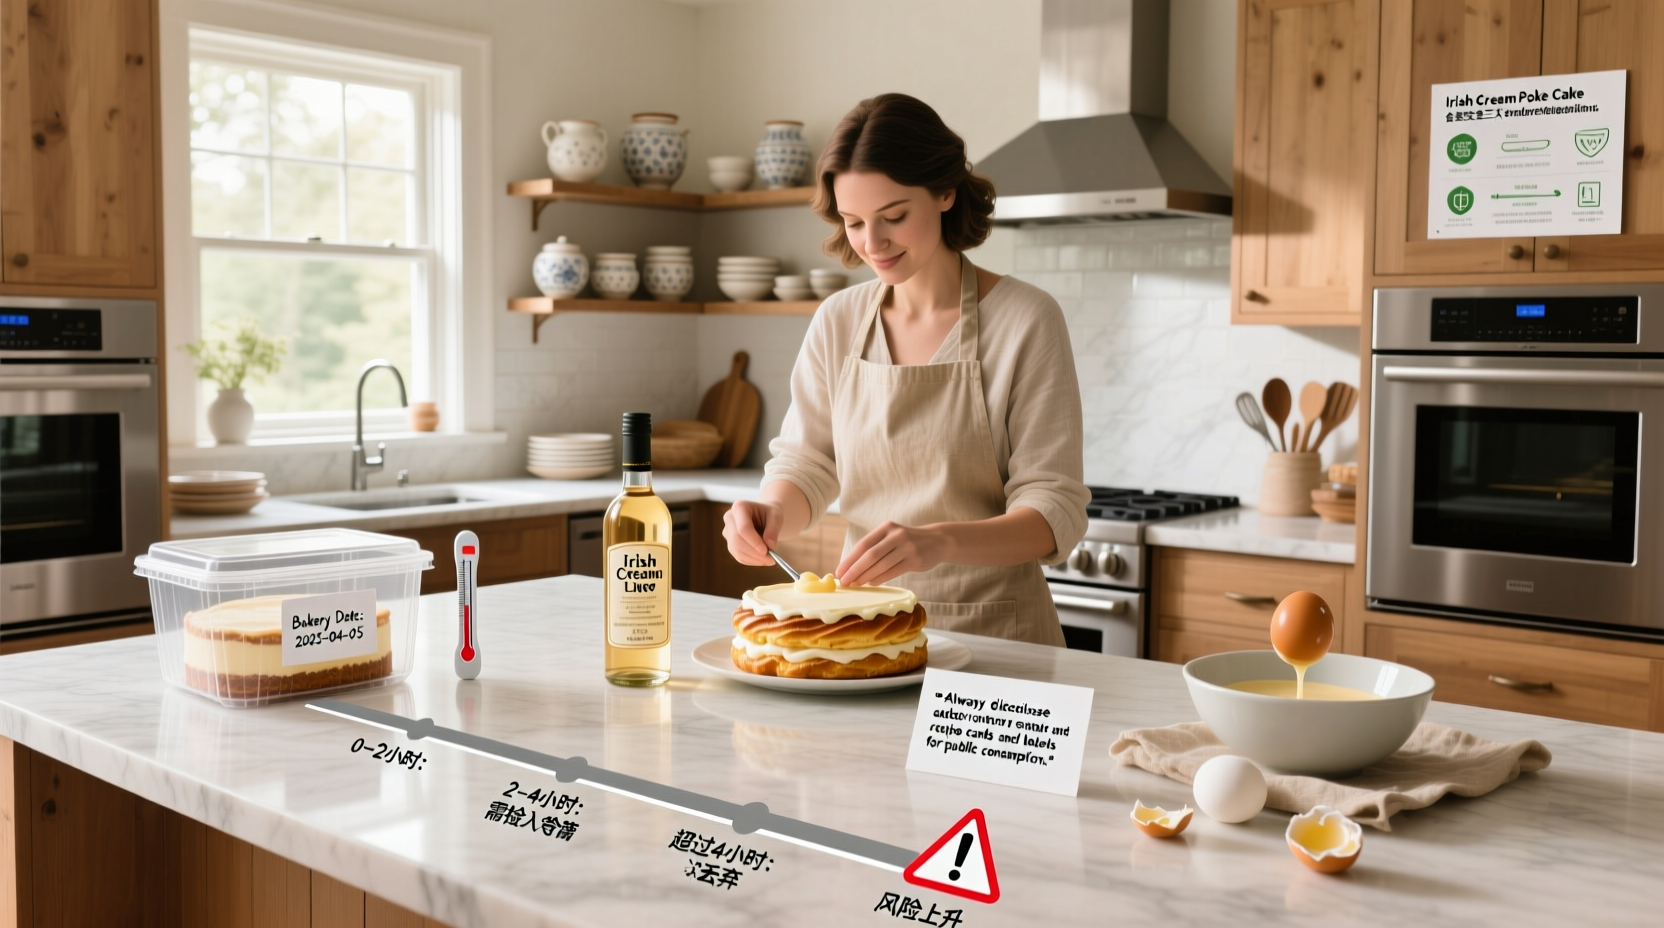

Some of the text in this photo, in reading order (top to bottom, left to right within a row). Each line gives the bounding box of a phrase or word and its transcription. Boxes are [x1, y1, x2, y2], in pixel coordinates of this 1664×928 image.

[1476, 93, 1517, 106] Cream
[1518, 89, 1549, 104] Poke
[1552, 86, 1585, 101] Cake
[624, 553, 657, 568] Irish
[292, 612, 331, 632] Bakery
[295, 625, 364, 648] 2025-04-05
[926, 735, 944, 748] for
[944, 740, 978, 754] public
[998, 732, 1021, 745] and
